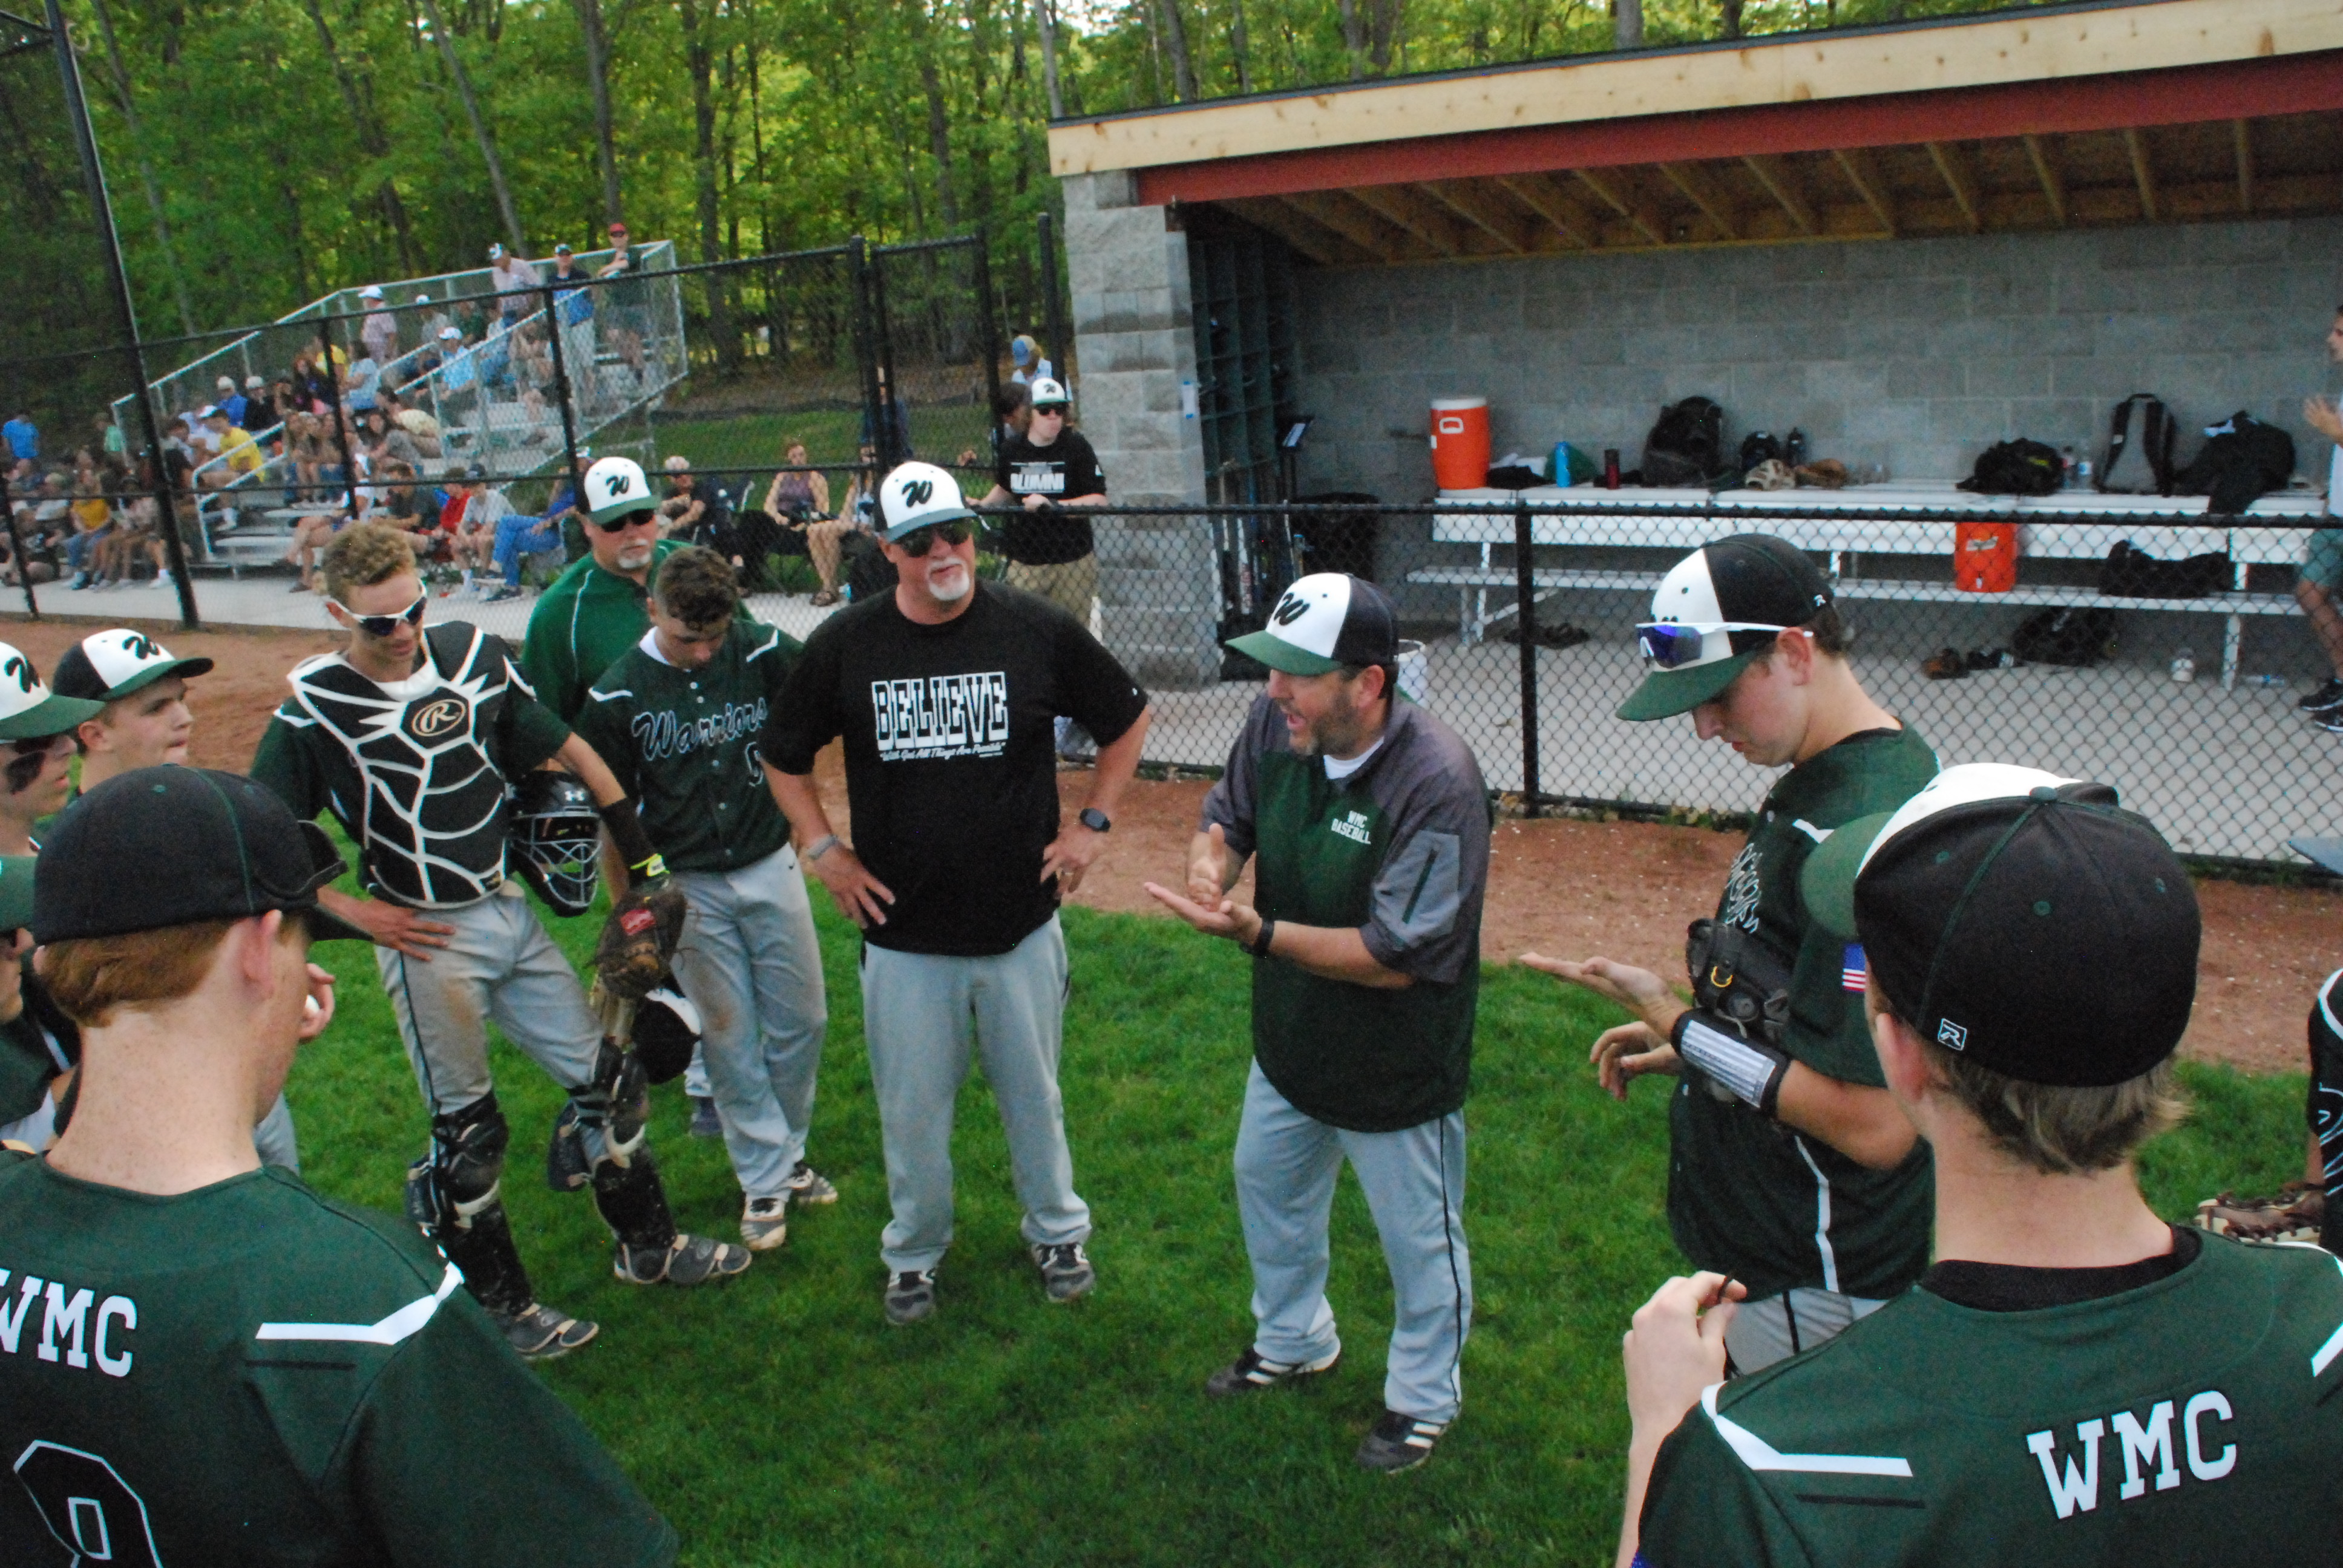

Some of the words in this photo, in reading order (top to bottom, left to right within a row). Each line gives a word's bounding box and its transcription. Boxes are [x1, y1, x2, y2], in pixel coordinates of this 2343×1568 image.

[902, 480, 933, 508] W
[1010, 472, 1064, 491] ALUMNI
[871, 671, 1009, 751] BELIEVE
[1331, 818, 1371, 844] BASEBALL
[1347, 811, 1368, 829] WMC
[2026, 1390, 2236, 1520] WMC
